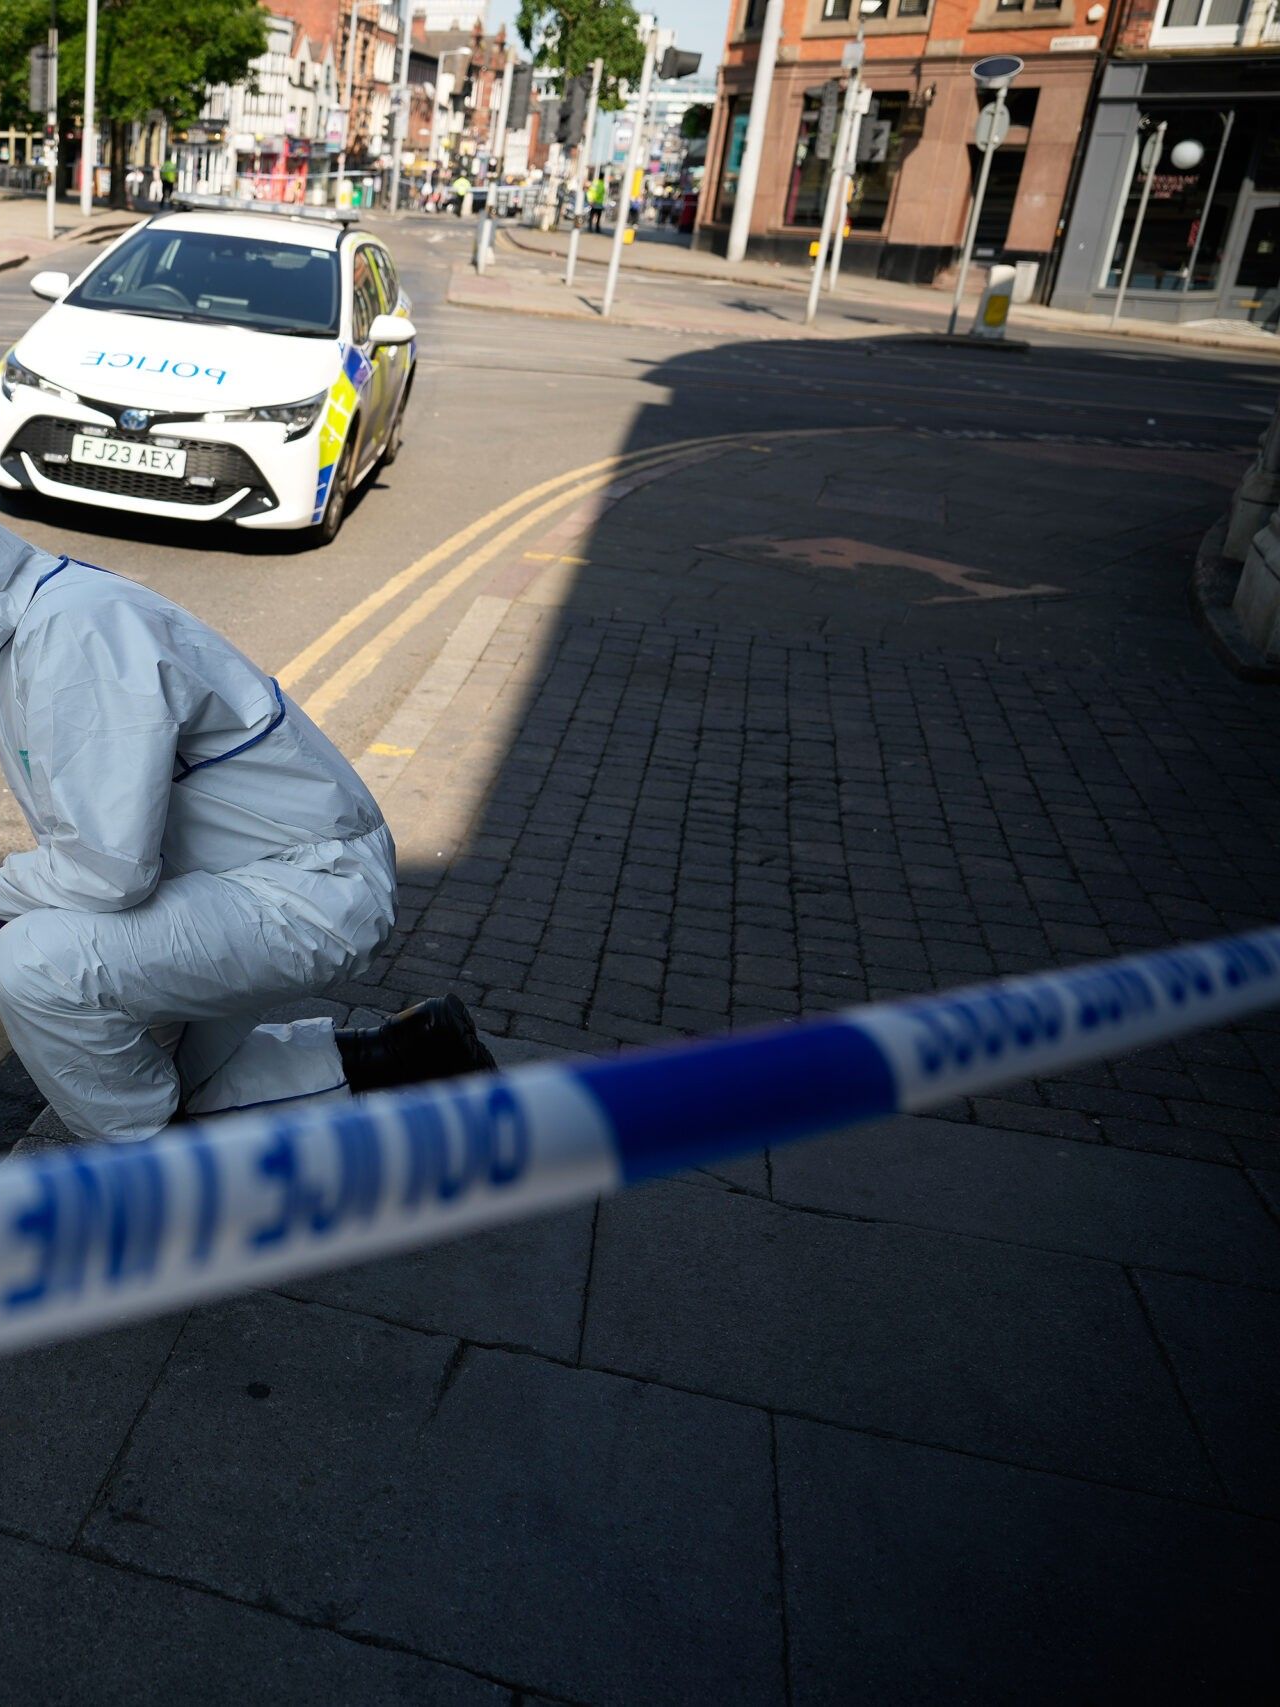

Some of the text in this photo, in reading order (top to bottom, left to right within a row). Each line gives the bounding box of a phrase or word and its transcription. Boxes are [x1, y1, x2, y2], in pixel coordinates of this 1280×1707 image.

[81, 440, 177, 471] FJ23 AEX
[249, 1086, 526, 1254] POLICE
